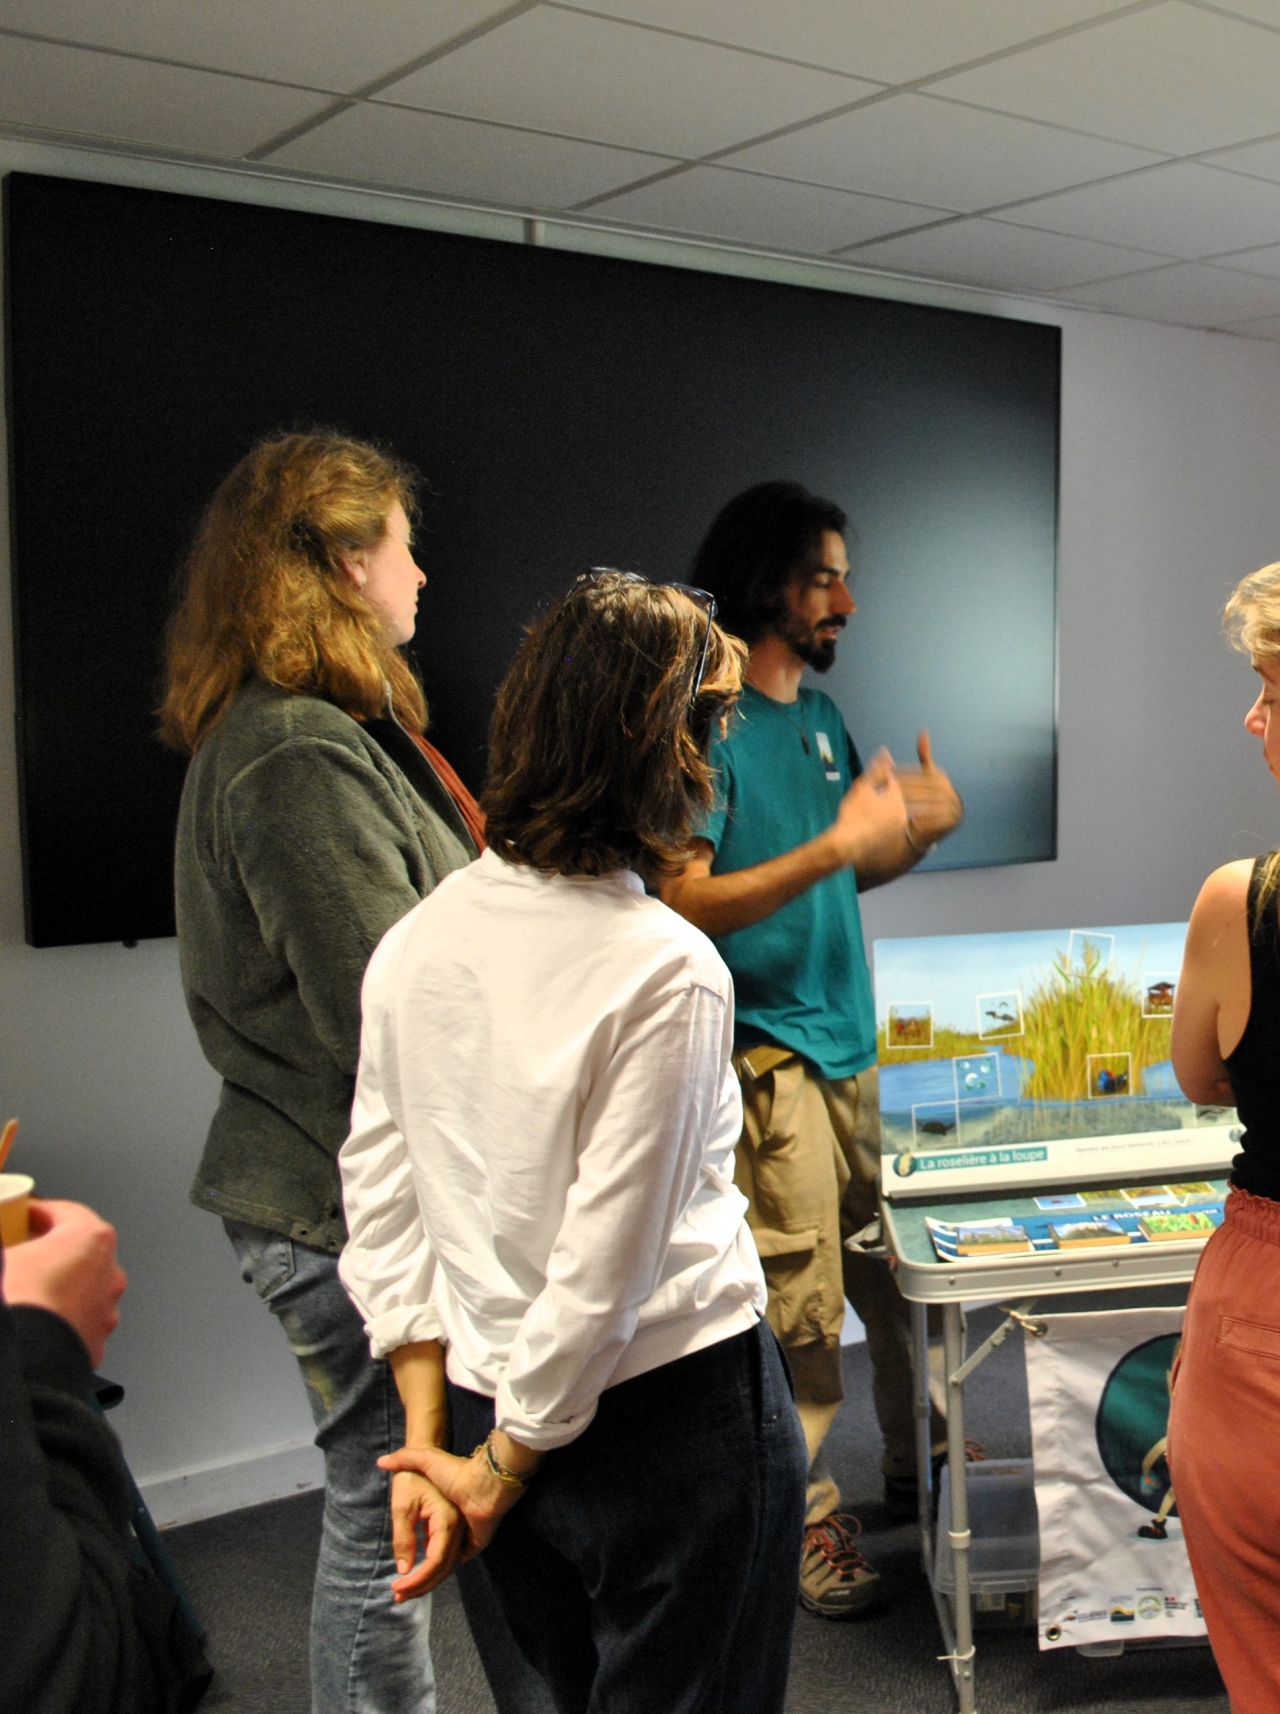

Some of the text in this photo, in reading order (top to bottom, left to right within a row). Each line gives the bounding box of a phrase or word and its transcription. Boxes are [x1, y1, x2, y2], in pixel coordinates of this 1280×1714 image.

[919, 1149, 1045, 1170] La roselière à la loupe
